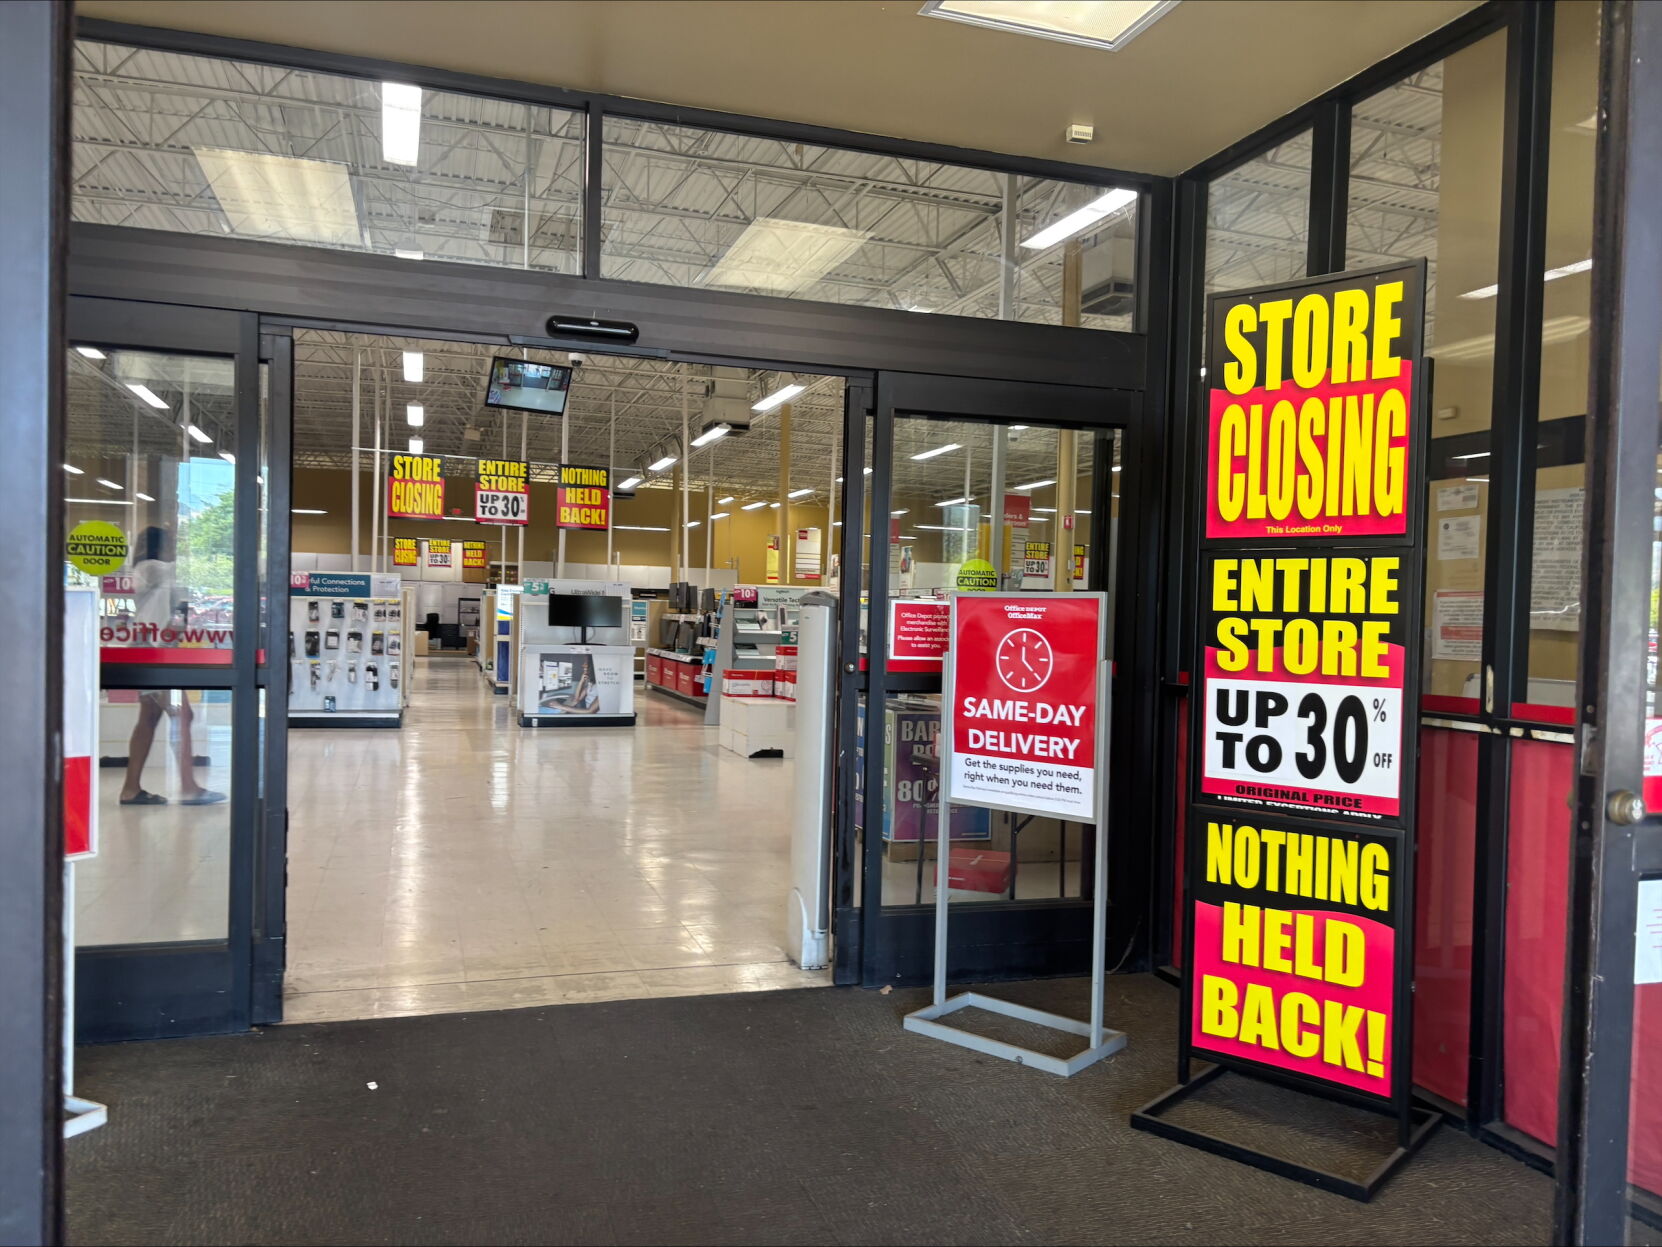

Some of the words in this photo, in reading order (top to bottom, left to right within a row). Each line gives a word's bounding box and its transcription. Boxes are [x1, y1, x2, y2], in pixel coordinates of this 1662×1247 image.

[1224, 281, 1404, 395] STORE
[1218, 388, 1407, 522] CLOSING
[393, 455, 441, 482] STORE
[478, 459, 527, 478] ENTIRE
[561, 467, 607, 487] NOTHING
[479, 476, 525, 492] STORE
[391, 482, 442, 515] CLOSING
[480, 493, 500, 504] UP
[501, 494, 520, 517] 30
[565, 487, 602, 506] HELD
[480, 505, 498, 516] TO
[559, 506, 606, 526] BACK!
[69, 534, 125, 544] AUTOMATIC
[1266, 526, 1283, 534] This
[1285, 525, 1320, 534] Location
[1323, 524, 1342, 534] Only
[67, 544, 127, 555] CAUTION
[395, 538, 416, 549] STORE
[1026, 542, 1049, 551] ENTIRE
[1025, 551, 1049, 560] STORE
[1035, 561, 1045, 573] 30
[115, 577, 130, 590] 10
[312, 585, 350, 593] Protection
[321, 577, 366, 586] Connections
[531, 582, 540, 592] 5
[957, 578, 996, 586] CAUTION
[1212, 556, 1400, 614] ENTIRE
[741, 588, 751, 598] 10
[789, 631, 797, 642] 5
[1216, 617, 1391, 678] STORE
[962, 696, 1087, 727] SAME-DAY
[1216, 688, 1289, 729] UP
[968, 728, 1081, 760] DELIVERY
[1215, 731, 1283, 773] TO
[1373, 752, 1393, 769] OFF
[964, 757, 981, 768] Get
[982, 760, 997, 770] the
[999, 763, 1035, 775] supplies
[1036, 768, 1054, 778] you
[1056, 770, 1082, 782] need,
[963, 771, 985, 783] right
[986, 774, 1010, 785] when
[1011, 778, 1029, 788] you
[1030, 780, 1053, 791] need
[1055, 783, 1083, 795] them.
[1235, 784, 1309, 803] ORIGINAL
[1313, 794, 1363, 809] PRICE
[1206, 822, 1389, 912] NOTHING
[1222, 901, 1365, 988] HELD
[1201, 973, 1387, 1079] BACK!
